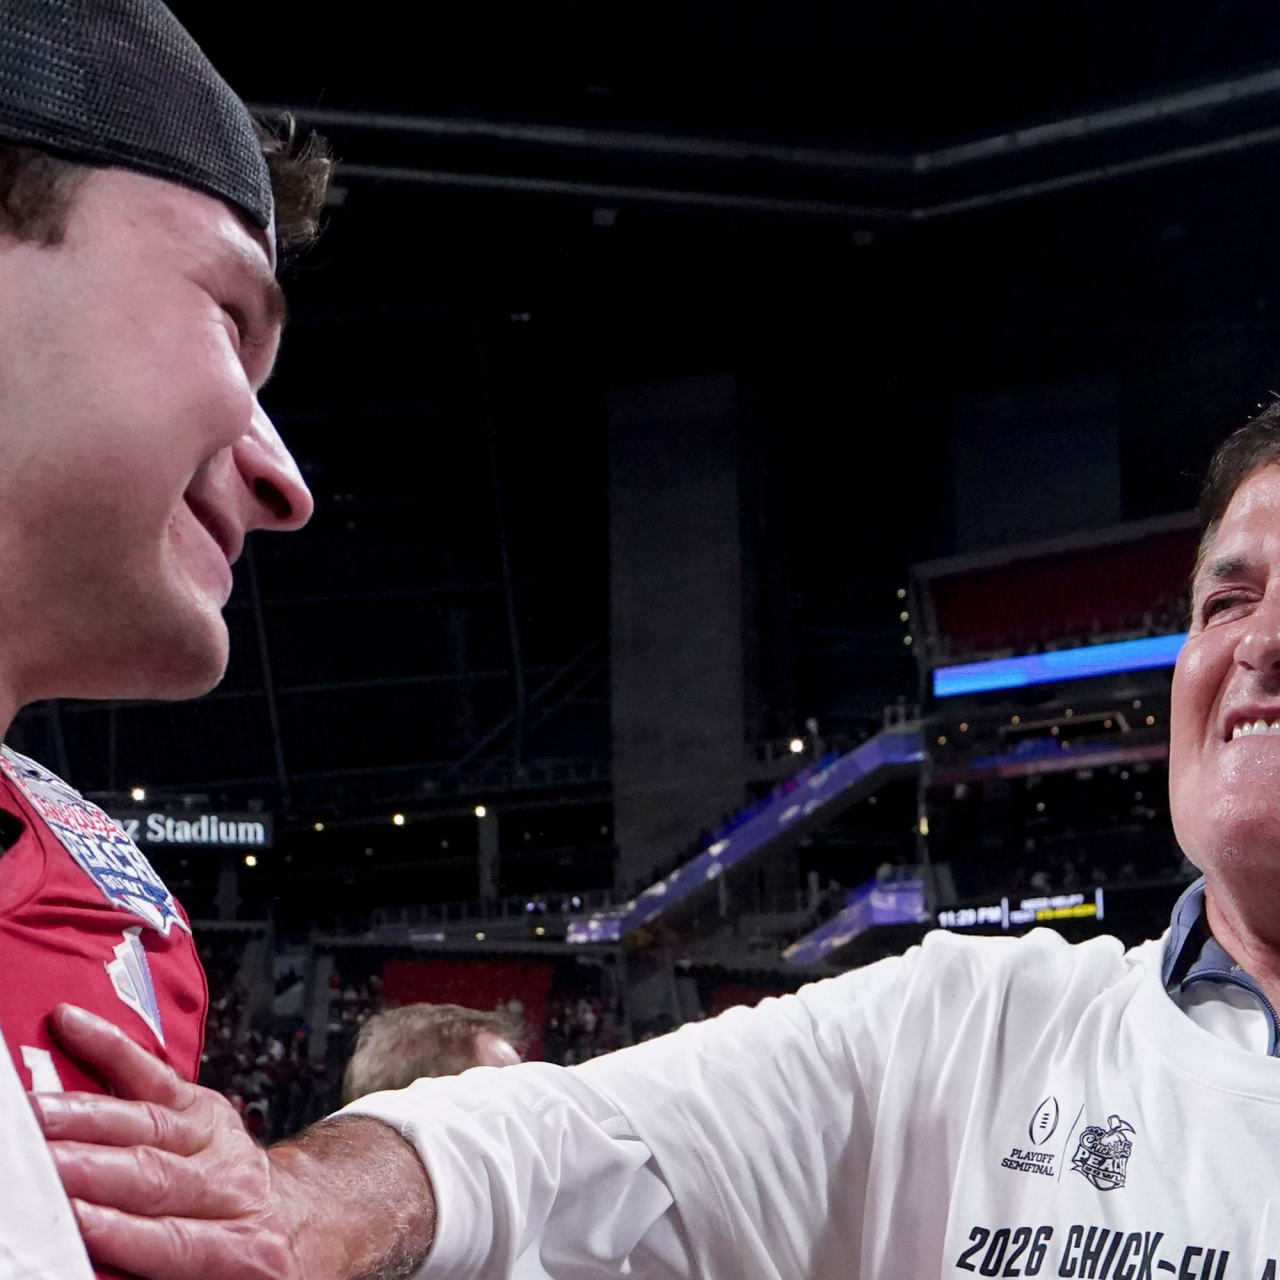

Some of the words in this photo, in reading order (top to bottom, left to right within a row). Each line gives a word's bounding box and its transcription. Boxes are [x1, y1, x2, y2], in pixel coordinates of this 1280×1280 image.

[146, 812, 265, 844] Stadium
[1001, 1157, 1054, 1176] SEMIFINAL
[1010, 1148, 1055, 1164] PLAYOFF
[956, 1226, 1054, 1278] 2026
